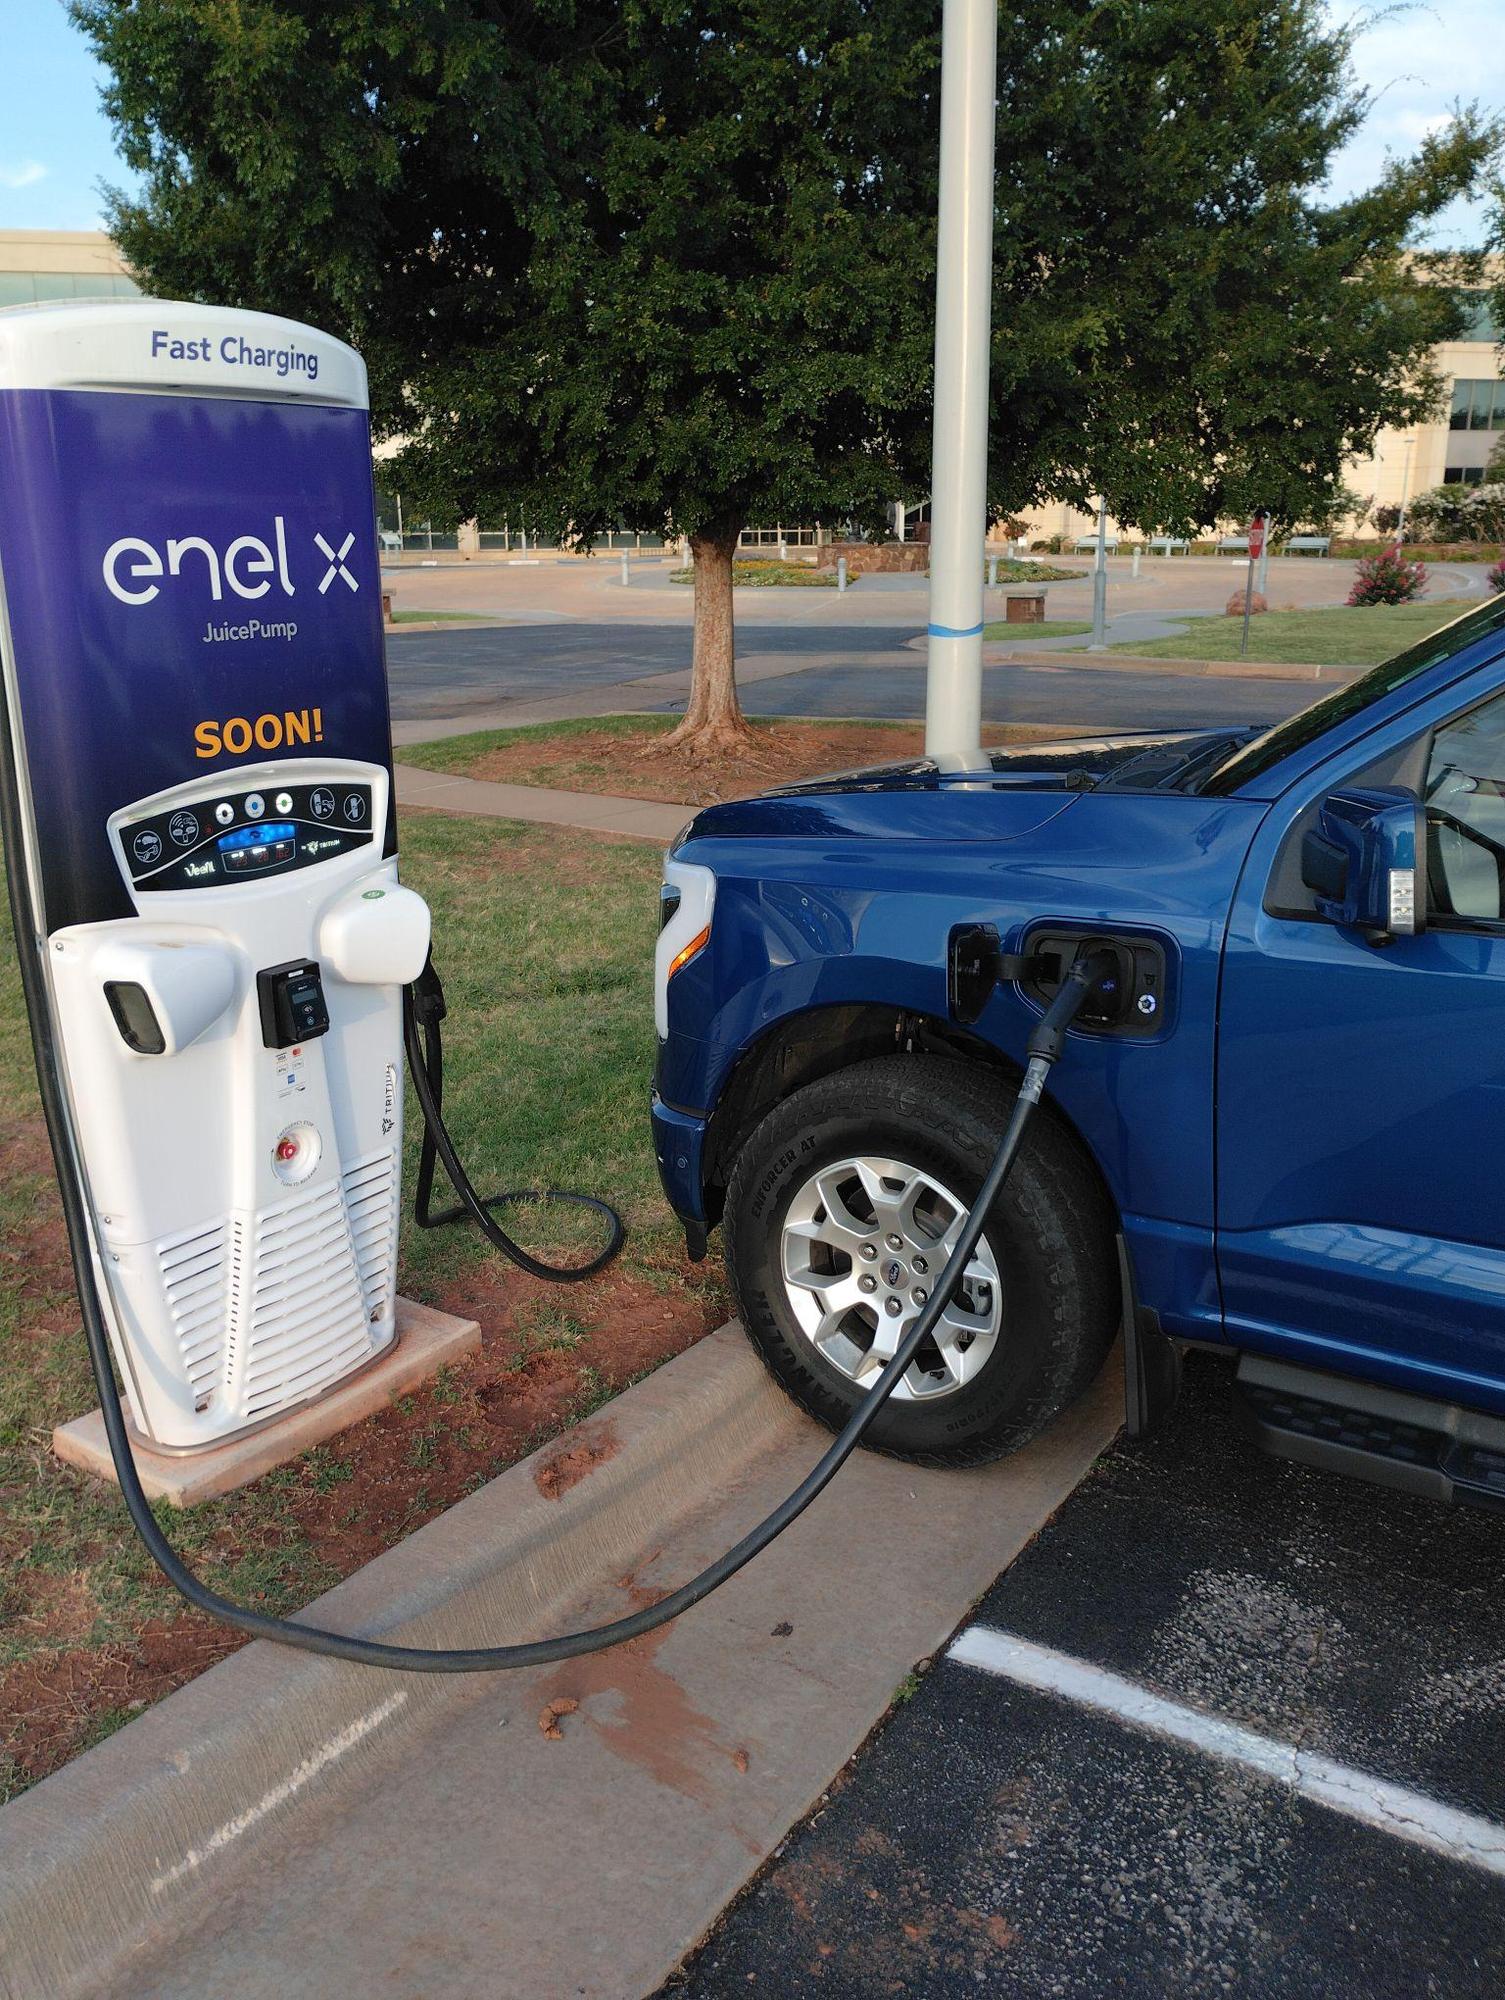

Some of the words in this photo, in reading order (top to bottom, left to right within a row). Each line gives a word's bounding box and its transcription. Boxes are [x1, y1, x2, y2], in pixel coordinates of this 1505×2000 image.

[151, 330, 211, 362] Fast
[220, 336, 319, 379] Charging
[102, 516, 296, 605] enel
[202, 619, 298, 643] JuicePump
[194, 708, 324, 759] SOON!
[384, 1063, 394, 1115] TRITIUM
[751, 1149, 797, 1217] ENFORCER
[801, 1135, 816, 1152] AT
